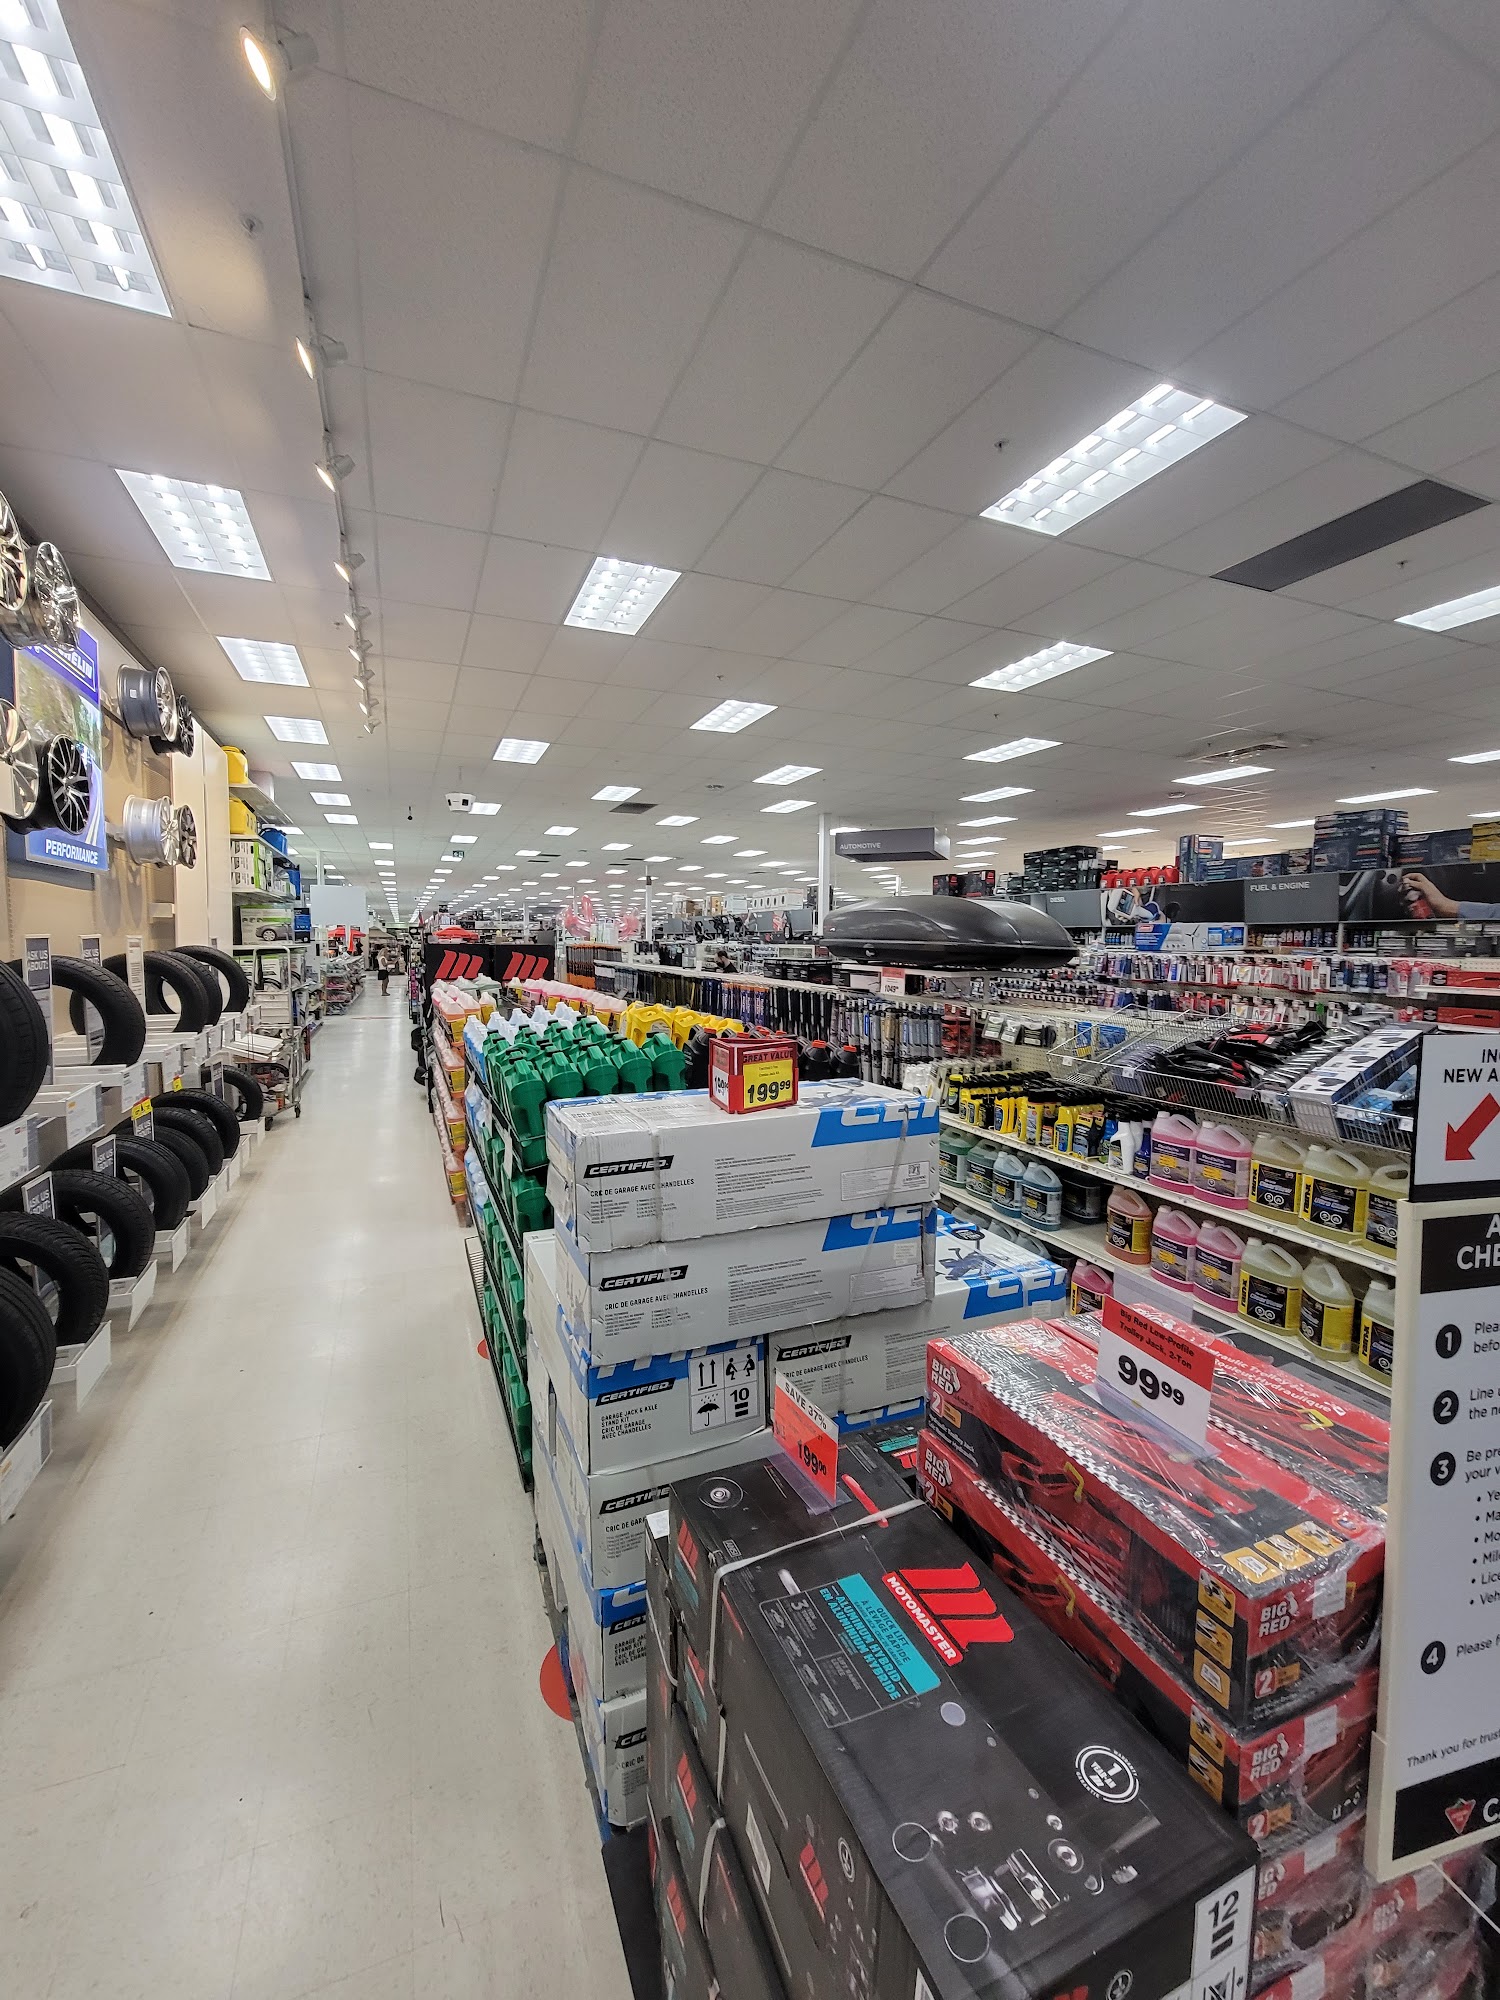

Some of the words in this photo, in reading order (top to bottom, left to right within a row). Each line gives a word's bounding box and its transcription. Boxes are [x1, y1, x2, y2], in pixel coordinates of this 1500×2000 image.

[46, 839, 98, 865] PERFORMANCE
[1250, 884, 1269, 892] FUEL
[1271, 883, 1277, 891] &
[1279, 881, 1310, 890] ENGINE
[40, 949, 48, 960] US
[743, 1053, 769, 1063] GREAT
[770, 1050, 793, 1060] VALUE
[1481, 1048, 1500, 1064] IN
[1444, 1068, 1483, 1083] NEW
[590, 1189, 603, 1198] CRIC
[605, 1187, 613, 1196] DE
[615, 1185, 639, 1195] GARAGE
[641, 1183, 656, 1192] AVEC
[659, 1178, 695, 1189] HANDELLES
[604, 1269, 683, 1289] CERTIFID
[605, 1302, 619, 1311] CRIC
[620, 1300, 628, 1308] DE
[630, 1296, 653, 1307] GARAGE
[1120, 1309, 1131, 1321] Big
[1134, 1316, 1148, 1330] Red
[1150, 1326, 1195, 1357] Low-Profile
[1119, 1321, 1144, 1342] Trolley
[1146, 1337, 1167, 1356] Jack,
[1169, 1350, 1192, 1370] 2-Ton
[804, 1364, 823, 1374] GARAGE
[824, 1361, 838, 1369] AVEC
[838, 1354, 869, 1367] CANDELLES
[932, 1358, 951, 1381] BIG
[1072, 1367, 1092, 1380] Cric
[931, 1371, 954, 1395] RED
[1249, 1365, 1291, 1386] Trolley
[601, 1381, 669, 1403] CERTIFIED
[730, 1387, 750, 1403] 10
[931, 1390, 941, 1414] 2
[1469, 1387, 1494, 1402] Line
[601, 1411, 623, 1422] GARAGE
[624, 1408, 638, 1417] JACK
[644, 1403, 658, 1412] AXLE
[785, 1382, 806, 1410] SAVE
[808, 1405, 827, 1430] 37%
[1469, 1406, 1488, 1420] the
[601, 1418, 620, 1428] STAND
[621, 1416, 629, 1424] KIT
[601, 1426, 615, 1435] CRIC
[624, 1419, 645, 1429] GARAGE
[601, 1431, 616, 1440] AVEC
[618, 1423, 652, 1437] CHANDELLES
[926, 1447, 944, 1474] BIG
[1467, 1449, 1481, 1463] Be
[924, 1459, 946, 1488] RED
[1465, 1466, 1492, 1484] your
[925, 1480, 935, 1504] 2
[605, 1524, 620, 1533] CRIC
[621, 1521, 629, 1530] DE
[1483, 1549, 1500, 1565] Mil
[791, 1599, 810, 1611] 3
[1261, 1601, 1287, 1623] BIG
[876, 1606, 897, 1631] QUICK
[893, 1629, 910, 1647] LIFT
[886, 1576, 957, 1660] MOTOMASTER
[1259, 1615, 1290, 1638] RED
[836, 1595, 874, 1644] ALUMINUM
[870, 1643, 901, 1683] HYBRID
[866, 1605, 889, 1634] LEVAGE
[886, 1632, 911, 1663] RAPIDE
[828, 1601, 869, 1654] ALUMINIUM
[864, 1653, 901, 1701] HYBRIDE
[1456, 1639, 1493, 1658] Please
[1260, 1671, 1273, 1696] 2
[1252, 1743, 1279, 1767] BIG
[1407, 1749, 1437, 1768] Thank
[1441, 1743, 1460, 1759] you
[1463, 1737, 1477, 1750] for
[1107, 1762, 1122, 1777] 1
[1250, 1757, 1282, 1782] RED
[1482, 1797, 1500, 1823] C
[1207, 1890, 1240, 1928] 12
